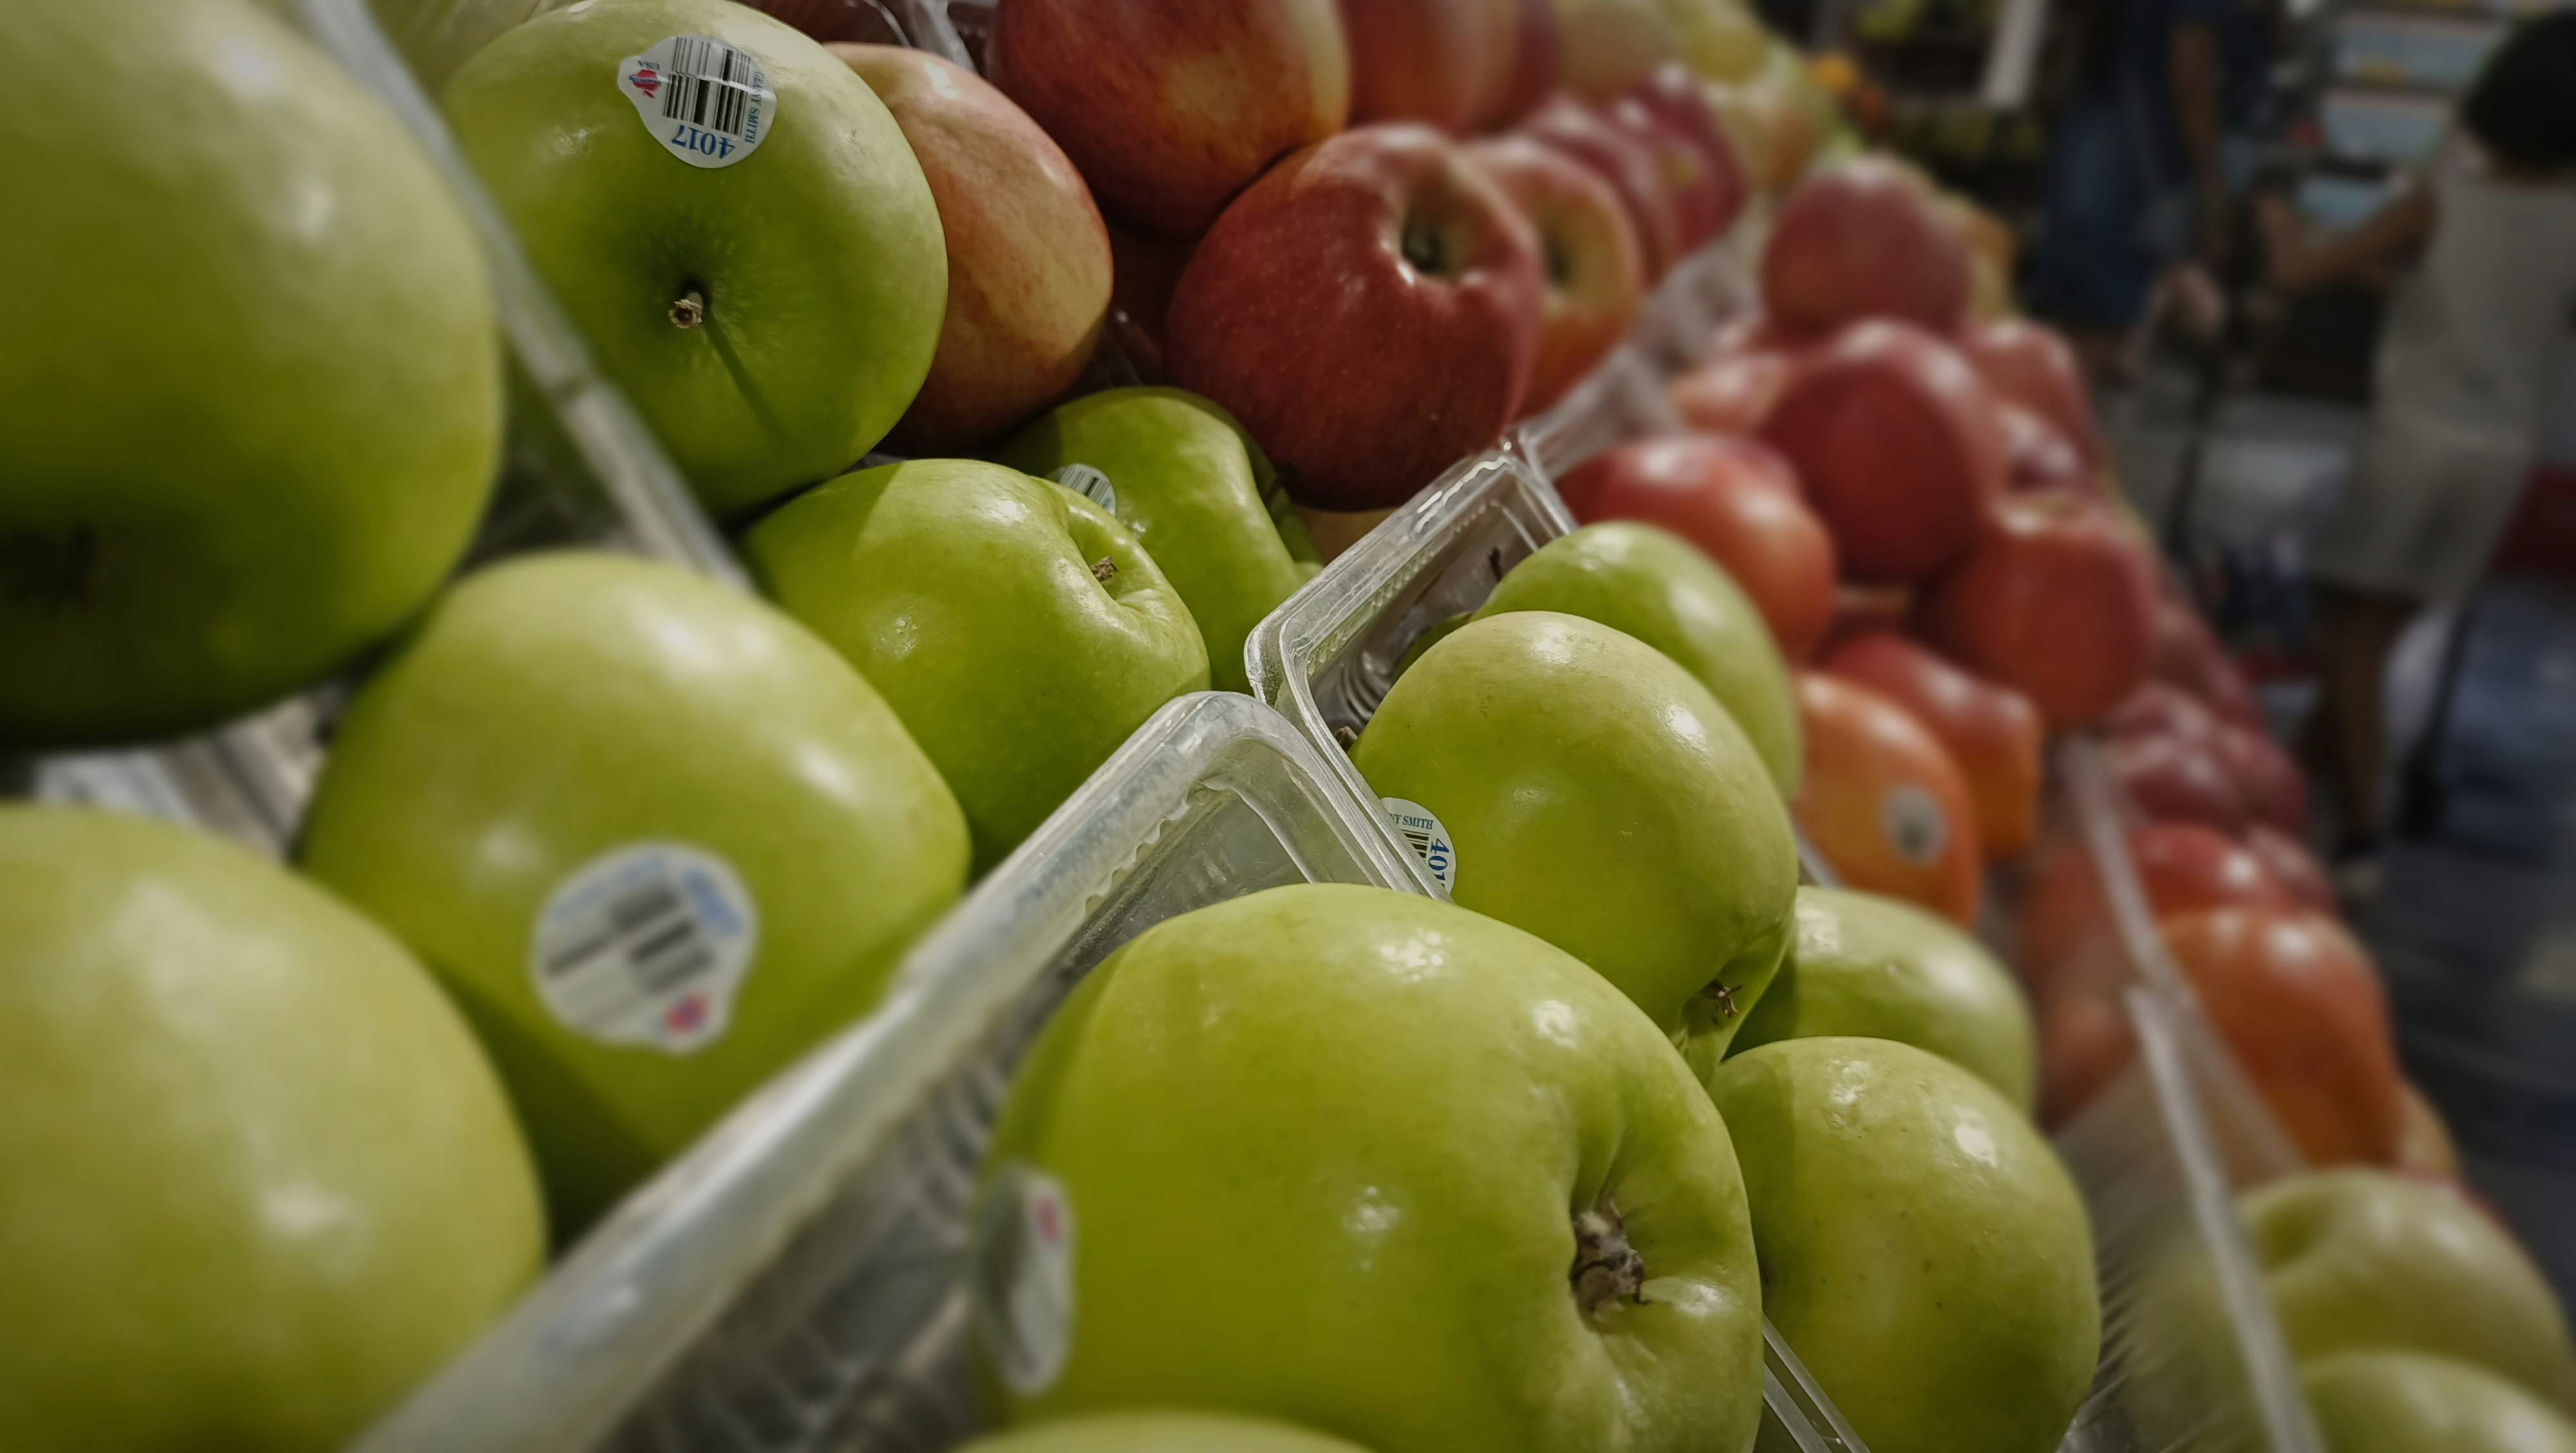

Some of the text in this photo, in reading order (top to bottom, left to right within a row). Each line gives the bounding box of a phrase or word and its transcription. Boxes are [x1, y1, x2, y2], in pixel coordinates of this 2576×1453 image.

[744, 71, 764, 145] GRANY SMITH
[671, 124, 735, 159] 4017
[1403, 815, 1434, 830] SMITH
[1428, 838, 1450, 888] 401
